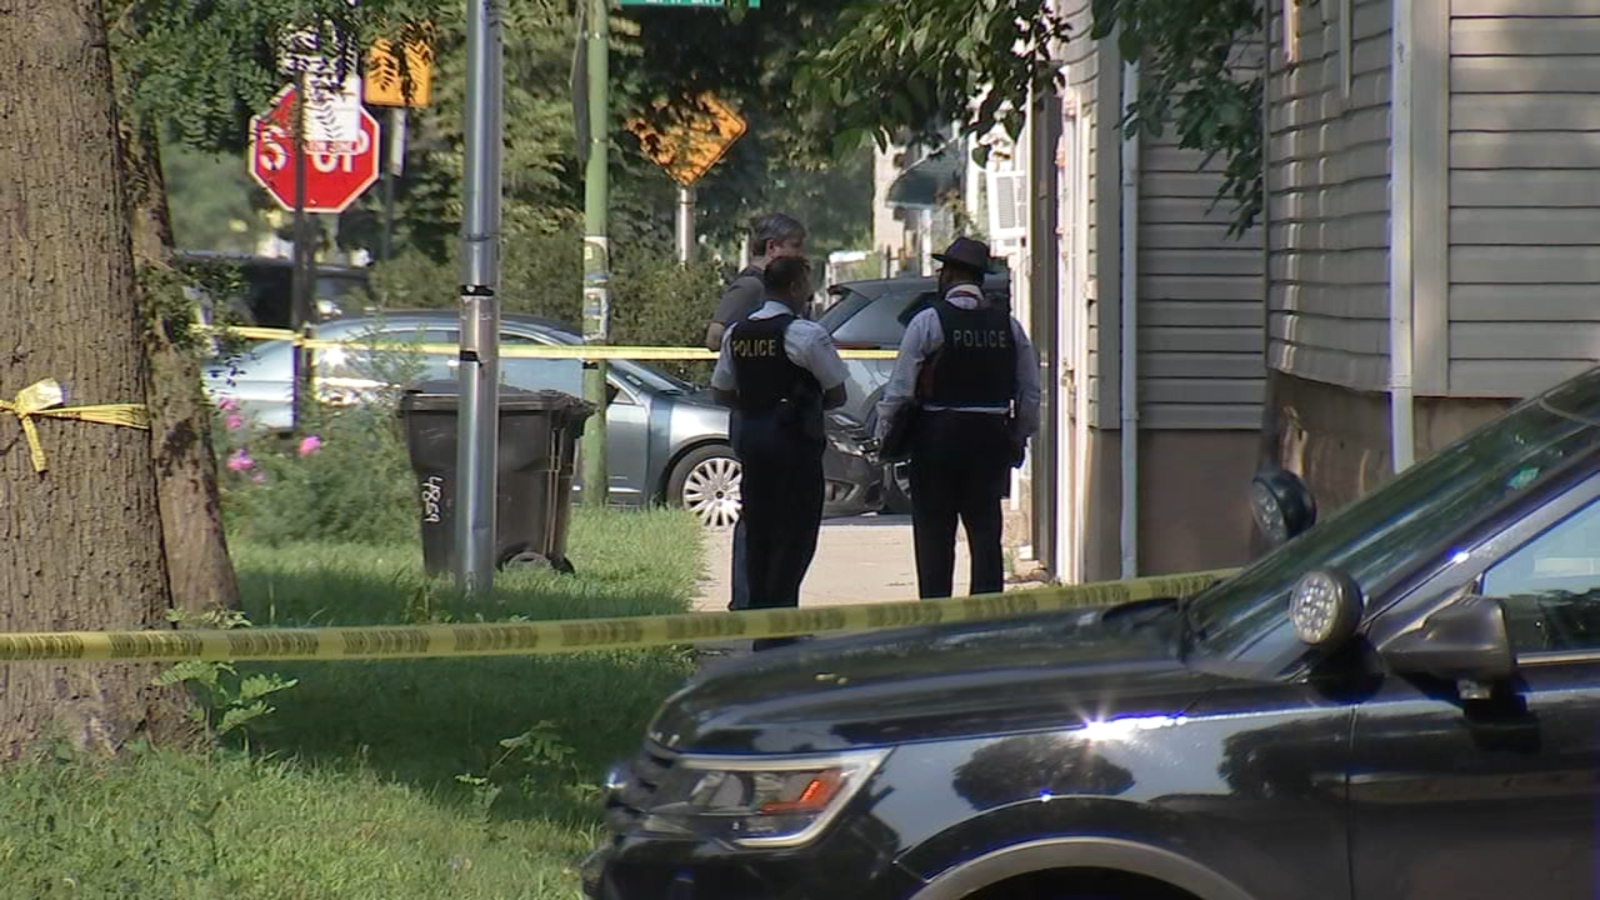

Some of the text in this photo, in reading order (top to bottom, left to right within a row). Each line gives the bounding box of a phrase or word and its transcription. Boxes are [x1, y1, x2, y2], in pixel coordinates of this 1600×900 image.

[260, 125, 370, 172] SP
[733, 339, 776, 357] POLICE
[953, 329, 1006, 348] POLICE
[422, 476, 443, 522] 4859
